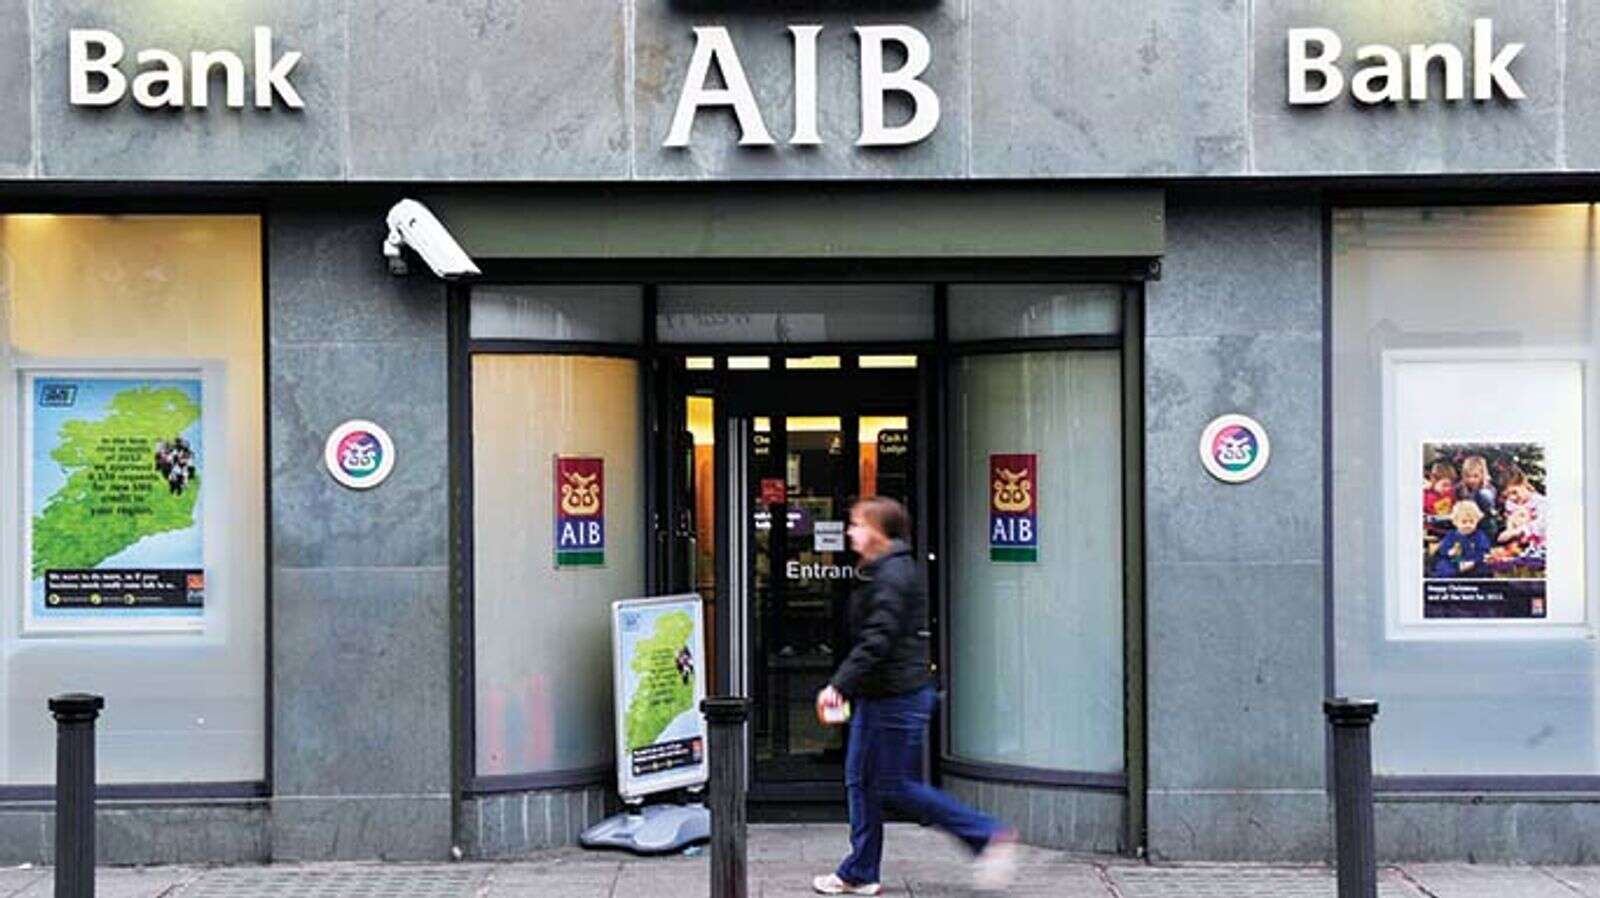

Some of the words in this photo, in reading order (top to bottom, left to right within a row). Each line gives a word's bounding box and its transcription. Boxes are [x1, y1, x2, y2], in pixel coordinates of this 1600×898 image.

[69, 26, 304, 108] Bank
[662, 25, 940, 146] AIB
[1288, 18, 1527, 105] Bank
[561, 522, 600, 545] AIB
[992, 518, 1033, 542] AIB
